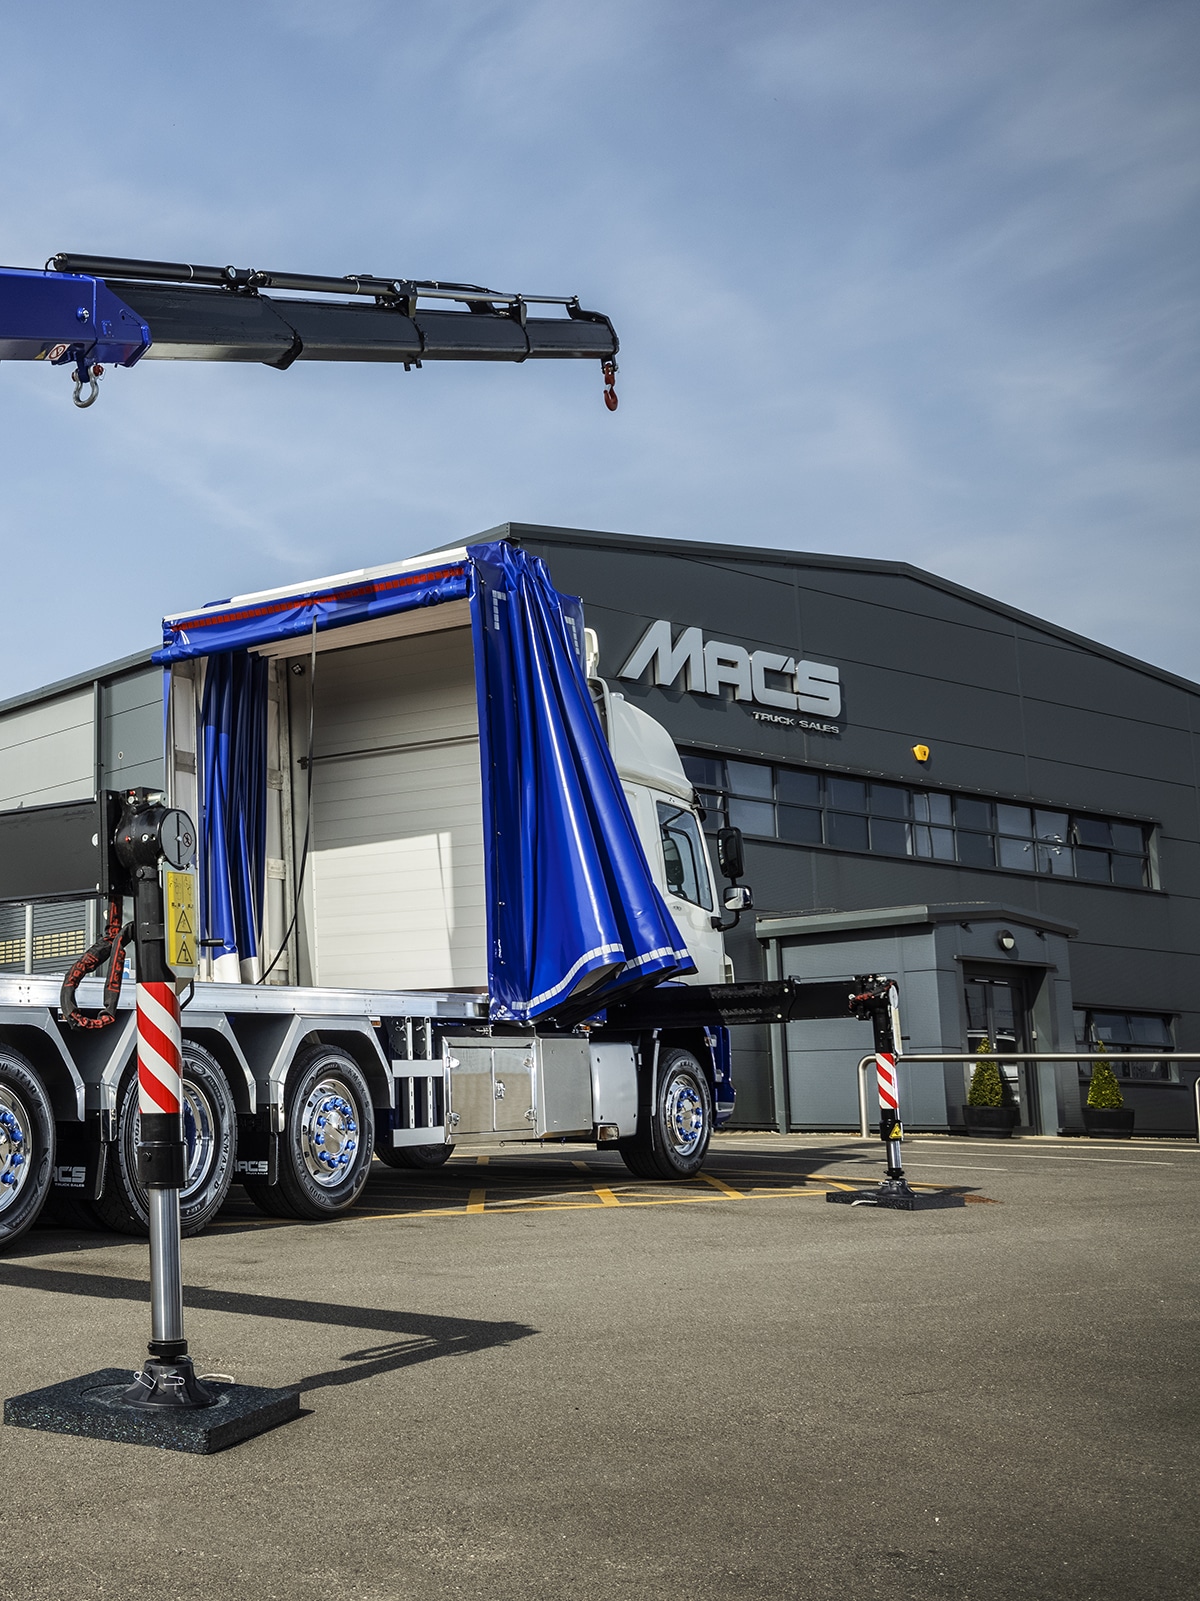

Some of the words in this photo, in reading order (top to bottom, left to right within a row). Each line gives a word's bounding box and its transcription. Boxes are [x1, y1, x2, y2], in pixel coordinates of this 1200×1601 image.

[752, 711, 795, 726] TRUCK
[799, 720, 840, 734] SALES
[15, 1068, 38, 1095] YEAR
[219, 1132, 229, 1173] KMAX
